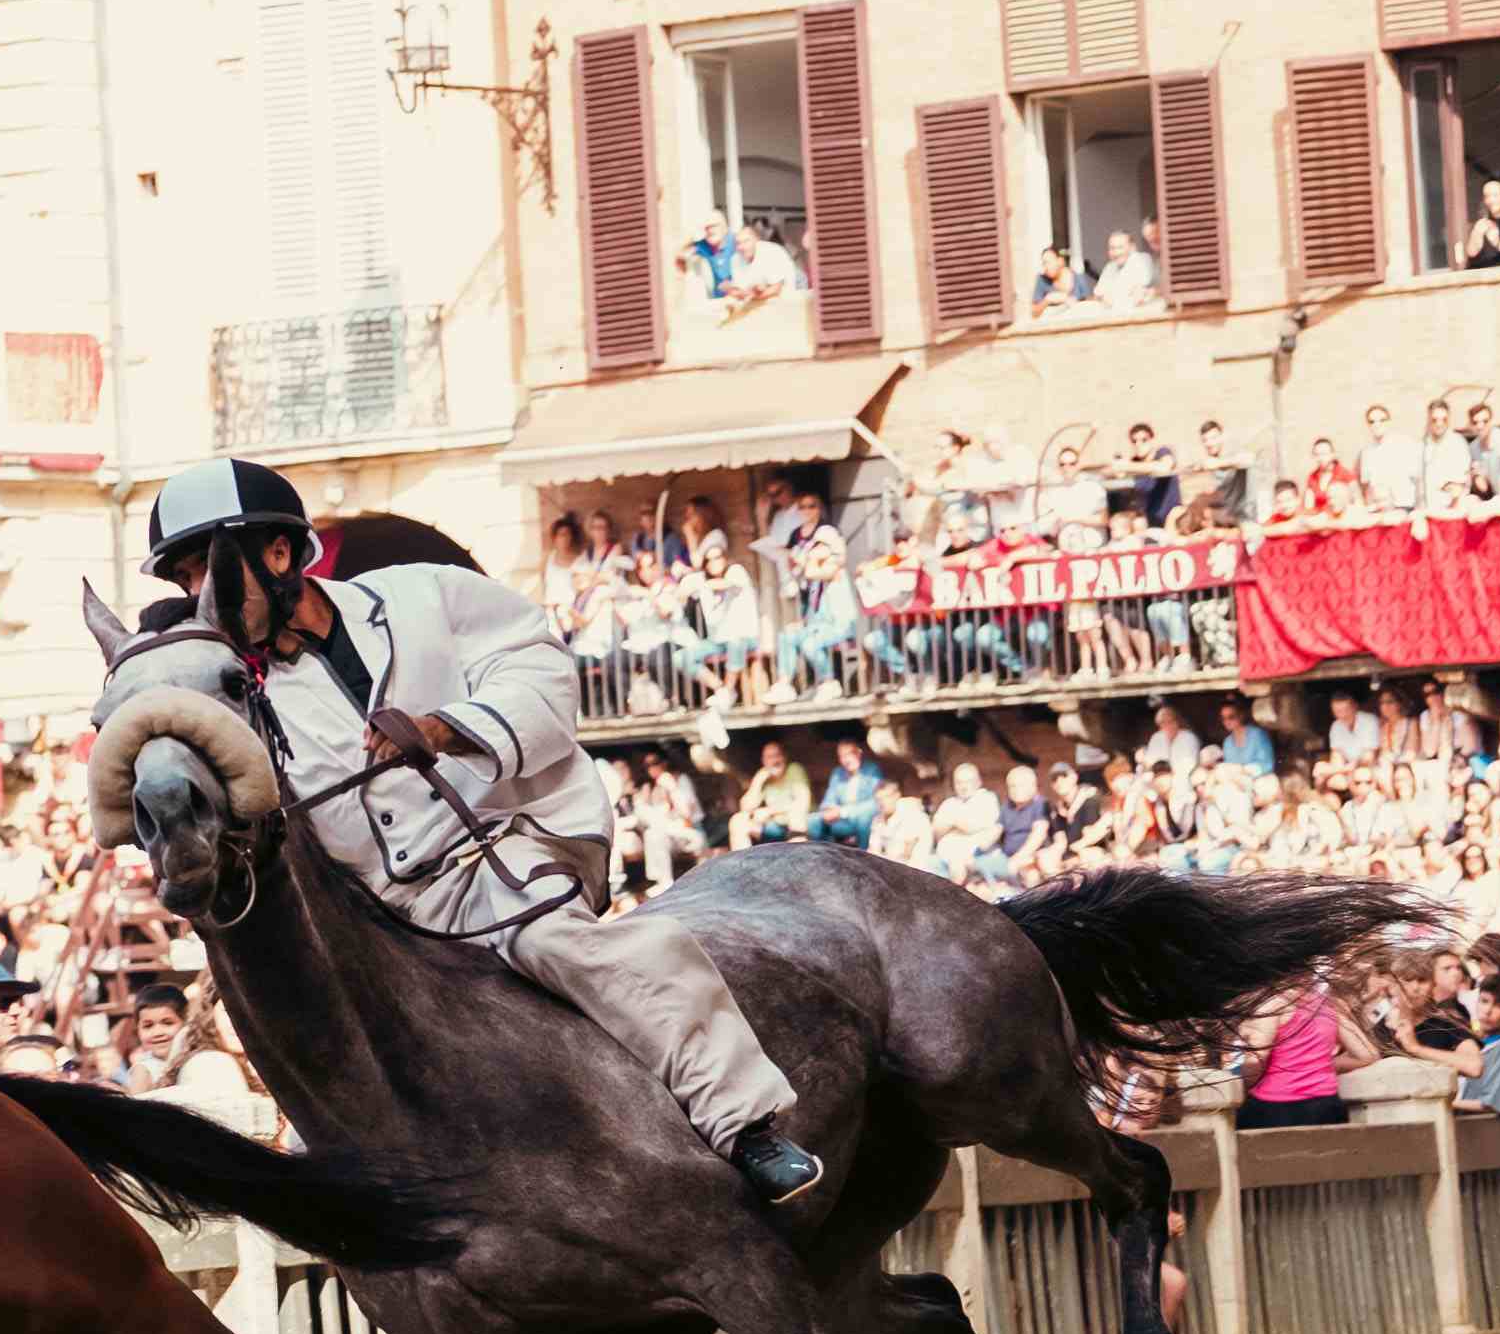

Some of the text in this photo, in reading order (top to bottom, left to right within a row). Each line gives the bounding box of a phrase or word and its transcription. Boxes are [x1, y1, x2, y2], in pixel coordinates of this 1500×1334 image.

[932, 549, 1196, 609] BAR IL PALIO
